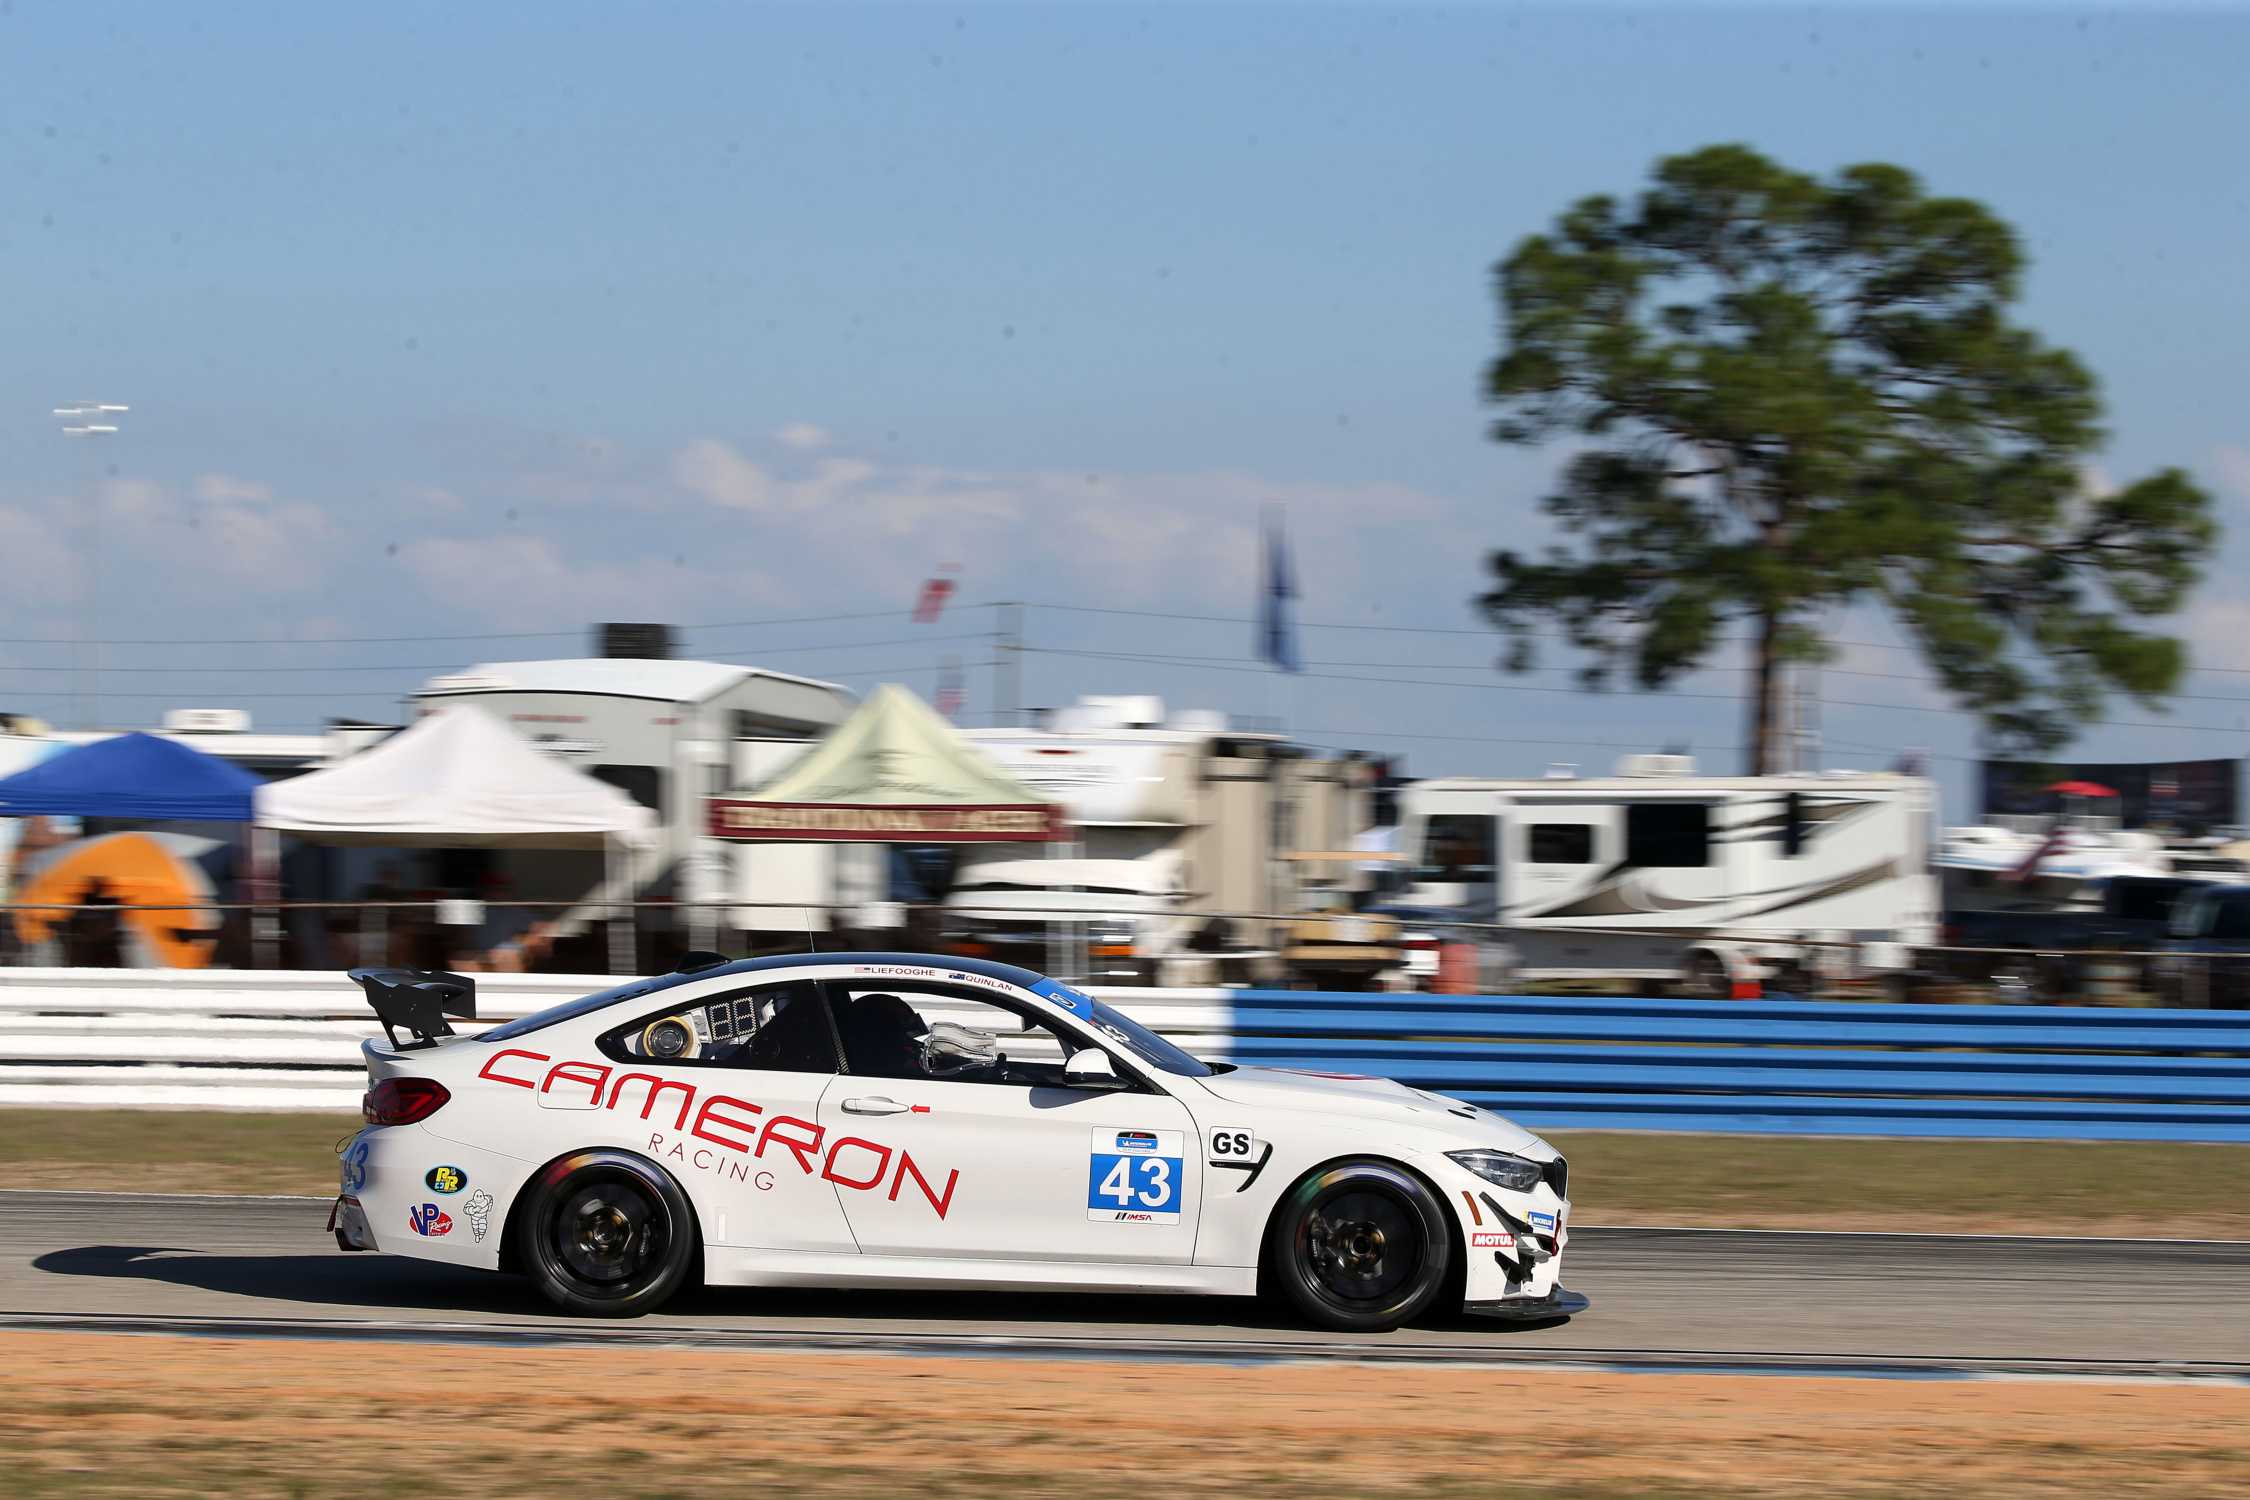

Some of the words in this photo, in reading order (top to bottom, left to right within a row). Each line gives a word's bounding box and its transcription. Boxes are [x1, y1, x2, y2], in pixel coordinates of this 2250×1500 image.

[871, 967, 936, 977] LIEFOOGHE
[965, 975, 1013, 992] QUINLAN
[478, 1048, 960, 1222] CAMERON
[1212, 1132, 1250, 1156] GS
[648, 1133, 777, 1192] RACING
[1099, 1156, 1171, 1207] 43
[409, 1202, 441, 1237] VP
[1126, 1213, 1153, 1221] IMSA
[1474, 1234, 1513, 1246] MOTUL
